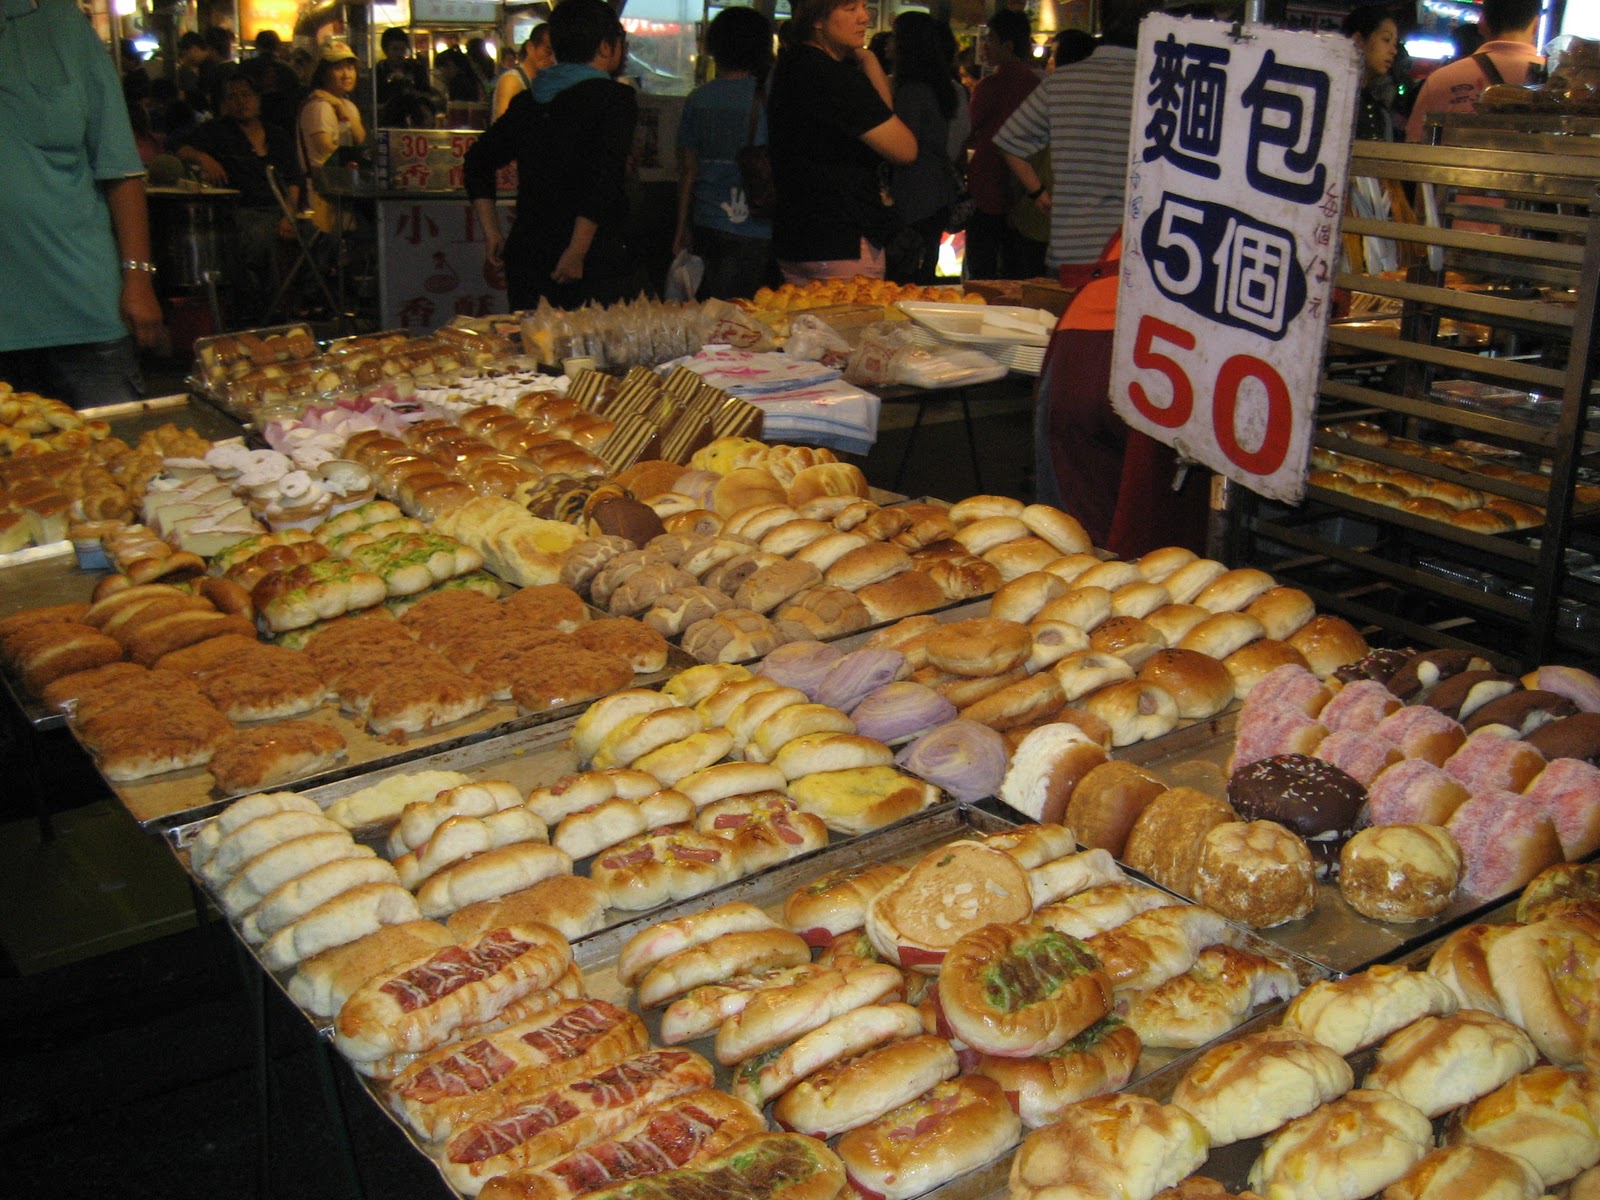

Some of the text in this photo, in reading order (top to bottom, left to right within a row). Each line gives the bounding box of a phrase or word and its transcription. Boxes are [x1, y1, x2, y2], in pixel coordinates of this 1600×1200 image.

[1143, 33, 1330, 205] 麵包
[1152, 196, 1294, 334] 5個
[1128, 314, 1293, 476] 50
